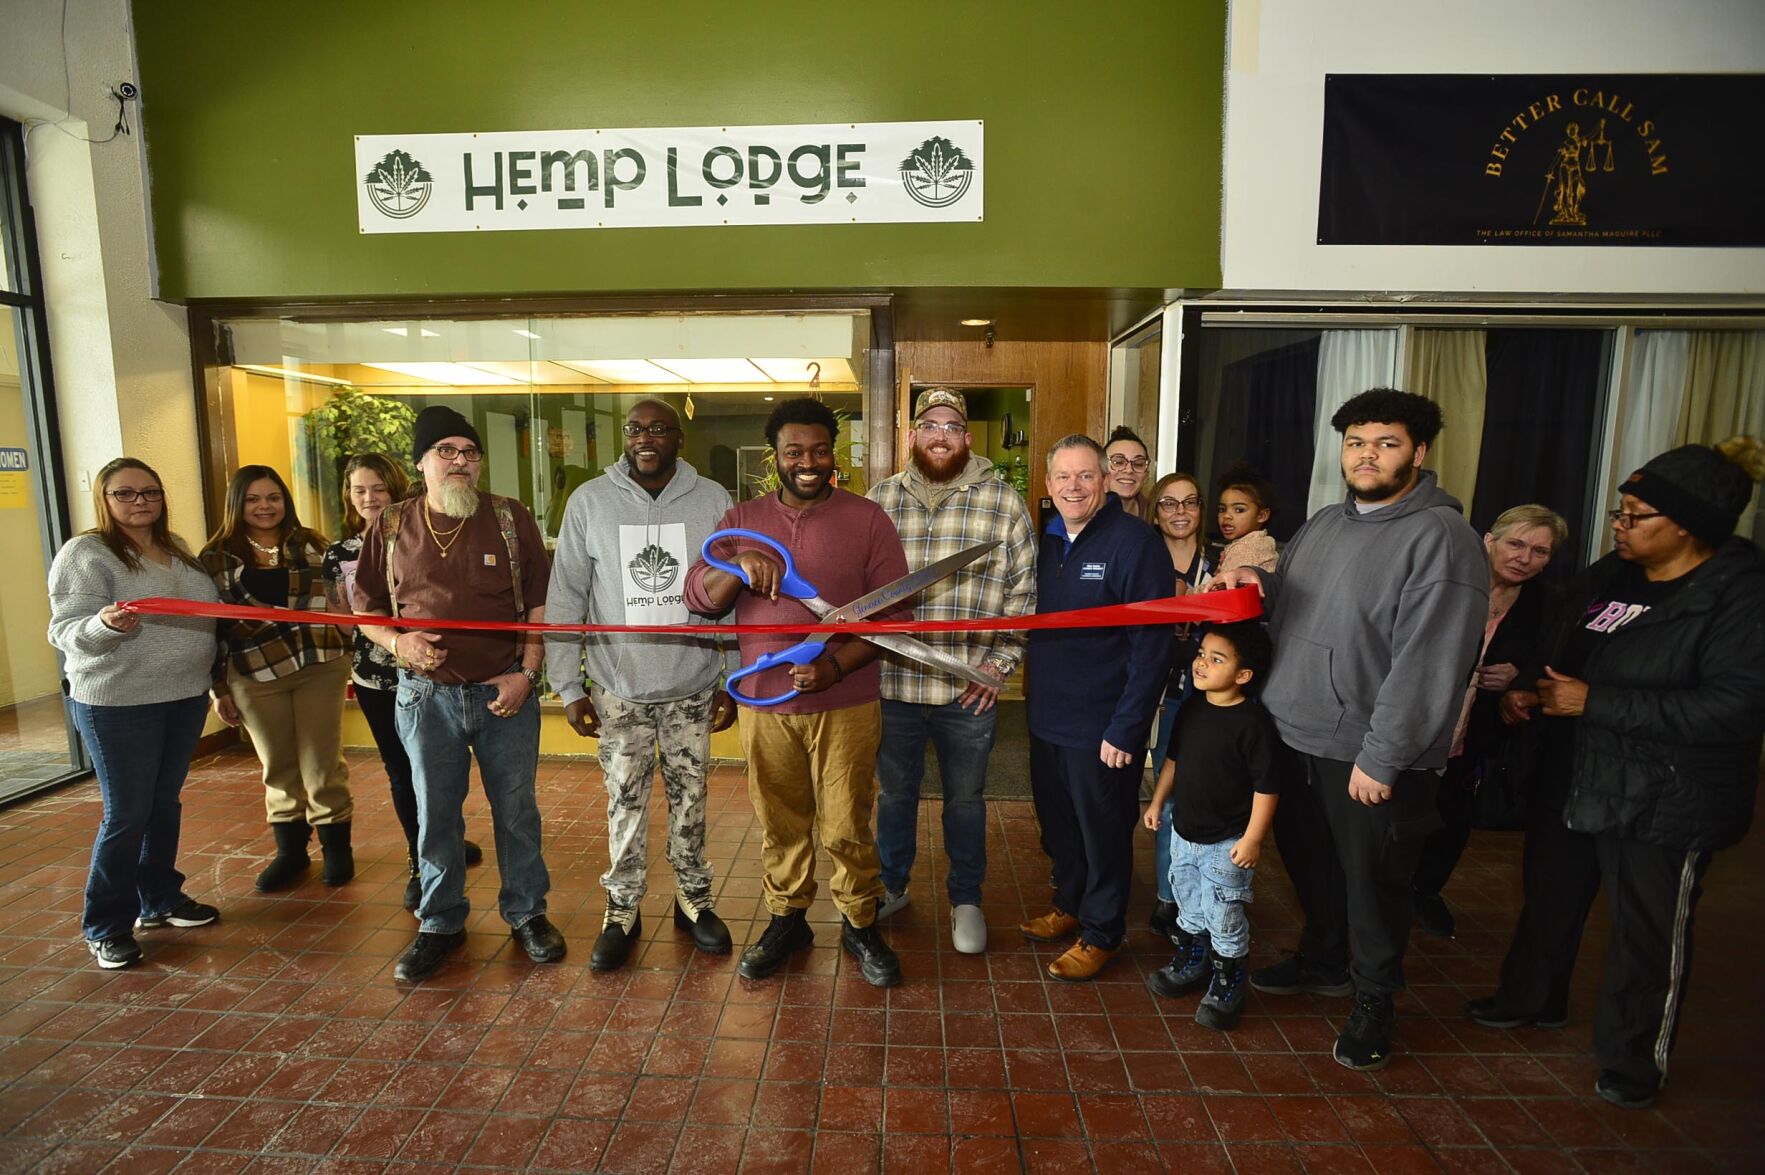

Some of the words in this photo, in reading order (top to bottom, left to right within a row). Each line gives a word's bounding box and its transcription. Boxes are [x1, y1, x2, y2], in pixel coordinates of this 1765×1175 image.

[1485, 94, 1563, 177] BETTER
[1573, 88, 1634, 122] CALL
[1637, 120, 1668, 176] SAM
[1476, 229, 1492, 237] THE
[1494, 229, 1511, 237] LAW
[1514, 229, 1541, 237] OFFICE
[1557, 230, 1599, 238] SAMANTHA
[1602, 230, 1639, 238] MAGUIRE
[0, 451, 26, 468] OMEN
